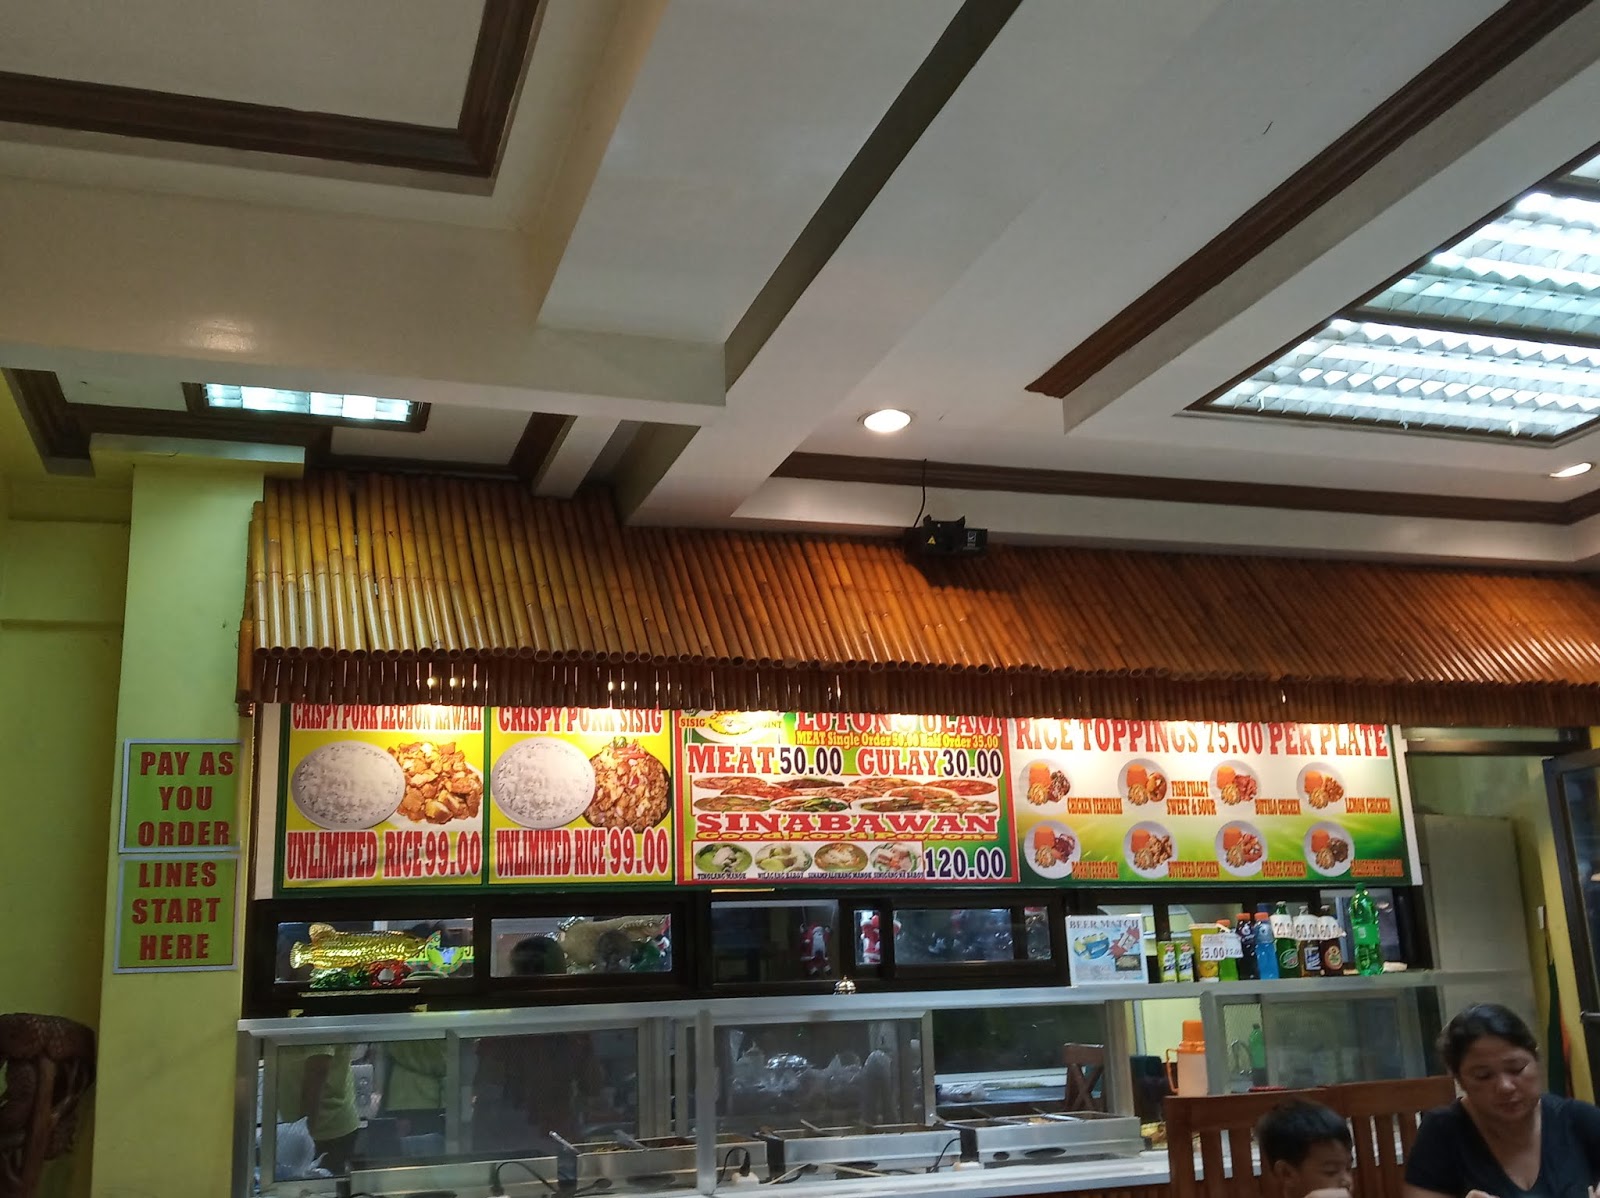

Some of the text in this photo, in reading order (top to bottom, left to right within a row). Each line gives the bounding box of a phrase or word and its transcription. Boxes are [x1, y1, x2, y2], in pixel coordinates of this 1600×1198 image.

[293, 703, 340, 730] CRISPY
[381, 704, 431, 730] LECHON
[499, 706, 561, 732] CRISPY
[620, 708, 663, 733] SISIG
[680, 718, 706, 728] SISIG
[922, 714, 1001, 736] ULAM
[796, 731, 826, 745] MEAT
[827, 733, 859, 749] Single
[861, 733, 890, 746] Order
[943, 735, 972, 748] Order
[973, 736, 999, 749] 35.00
[1015, 717, 1388, 757] RICE TOPPINGS 75.00 PER PLATE
[140, 751, 235, 776] PAY AS
[687, 745, 1002, 776] MEAT 50.00 GULAY 30.00
[159, 786, 213, 811] YOU
[138, 821, 230, 846] ORDER
[697, 812, 998, 833] SINABAWAN
[696, 831, 784, 841] Good
[874, 831, 998, 841] Persons
[287, 831, 481, 880] UNLIMITED RICE 99.00
[496, 828, 669, 877] UNLIMITED RICE 99.00
[925, 848, 1005, 879] 120.00
[139, 862, 217, 888] LINES
[131, 898, 221, 924] START
[1069, 919, 1139, 929] BEER MATCH
[139, 934, 210, 960] HERE
